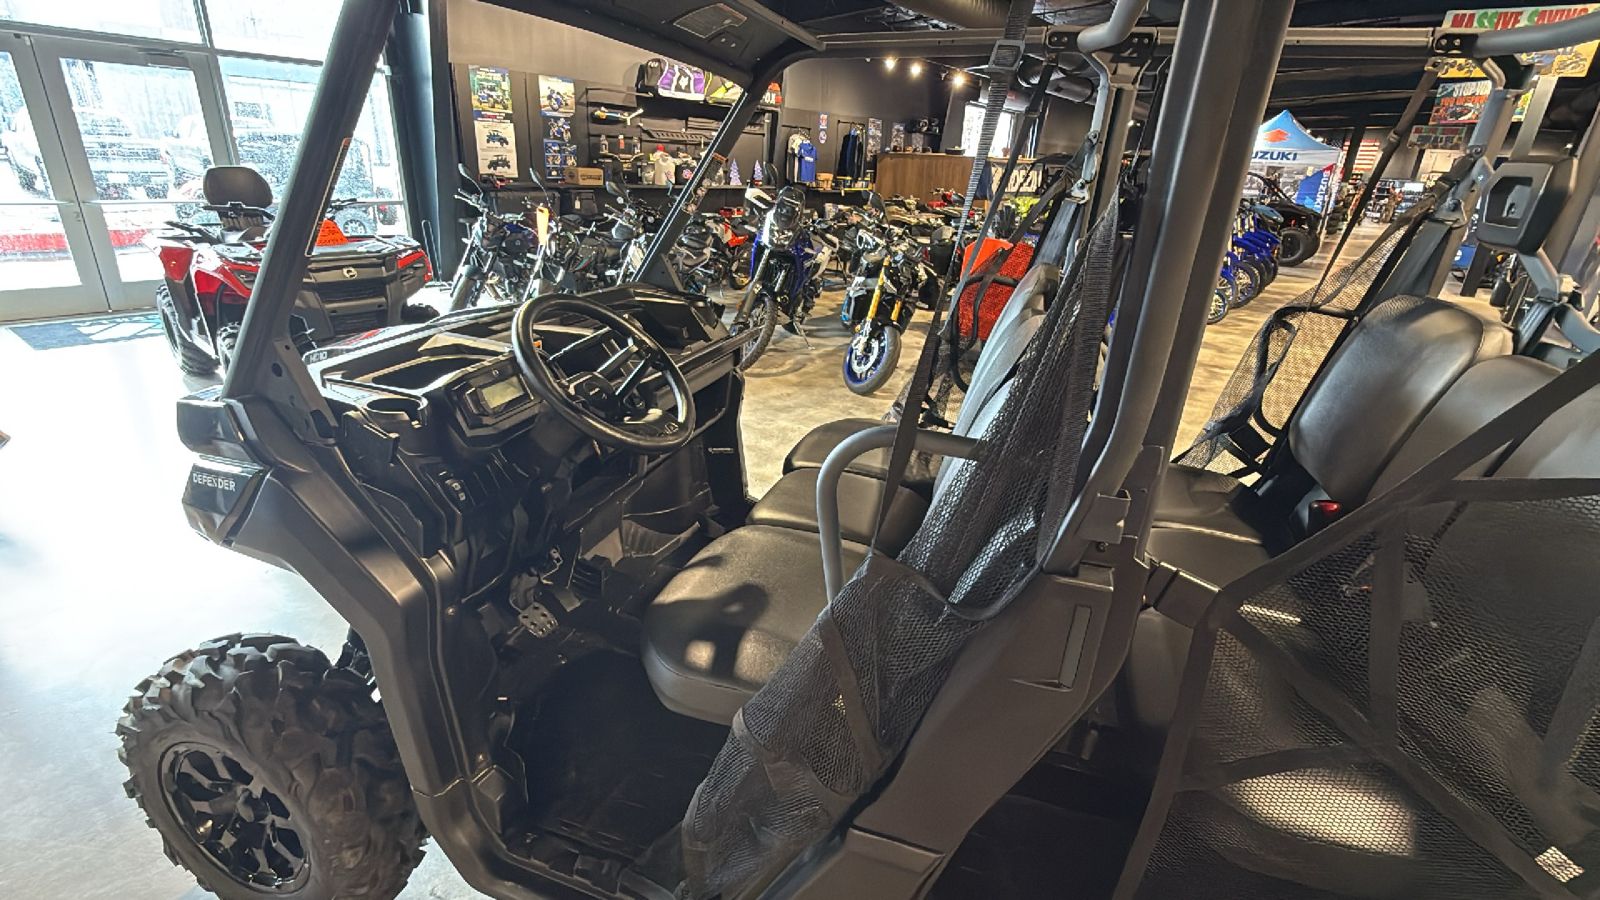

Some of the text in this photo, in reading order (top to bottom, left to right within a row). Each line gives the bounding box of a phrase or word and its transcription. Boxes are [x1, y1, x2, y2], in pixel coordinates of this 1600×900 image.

[1451, 11, 1523, 30] MASSIVE
[1252, 151, 1297, 161] UZUKI
[192, 473, 236, 491] DEFENDER
